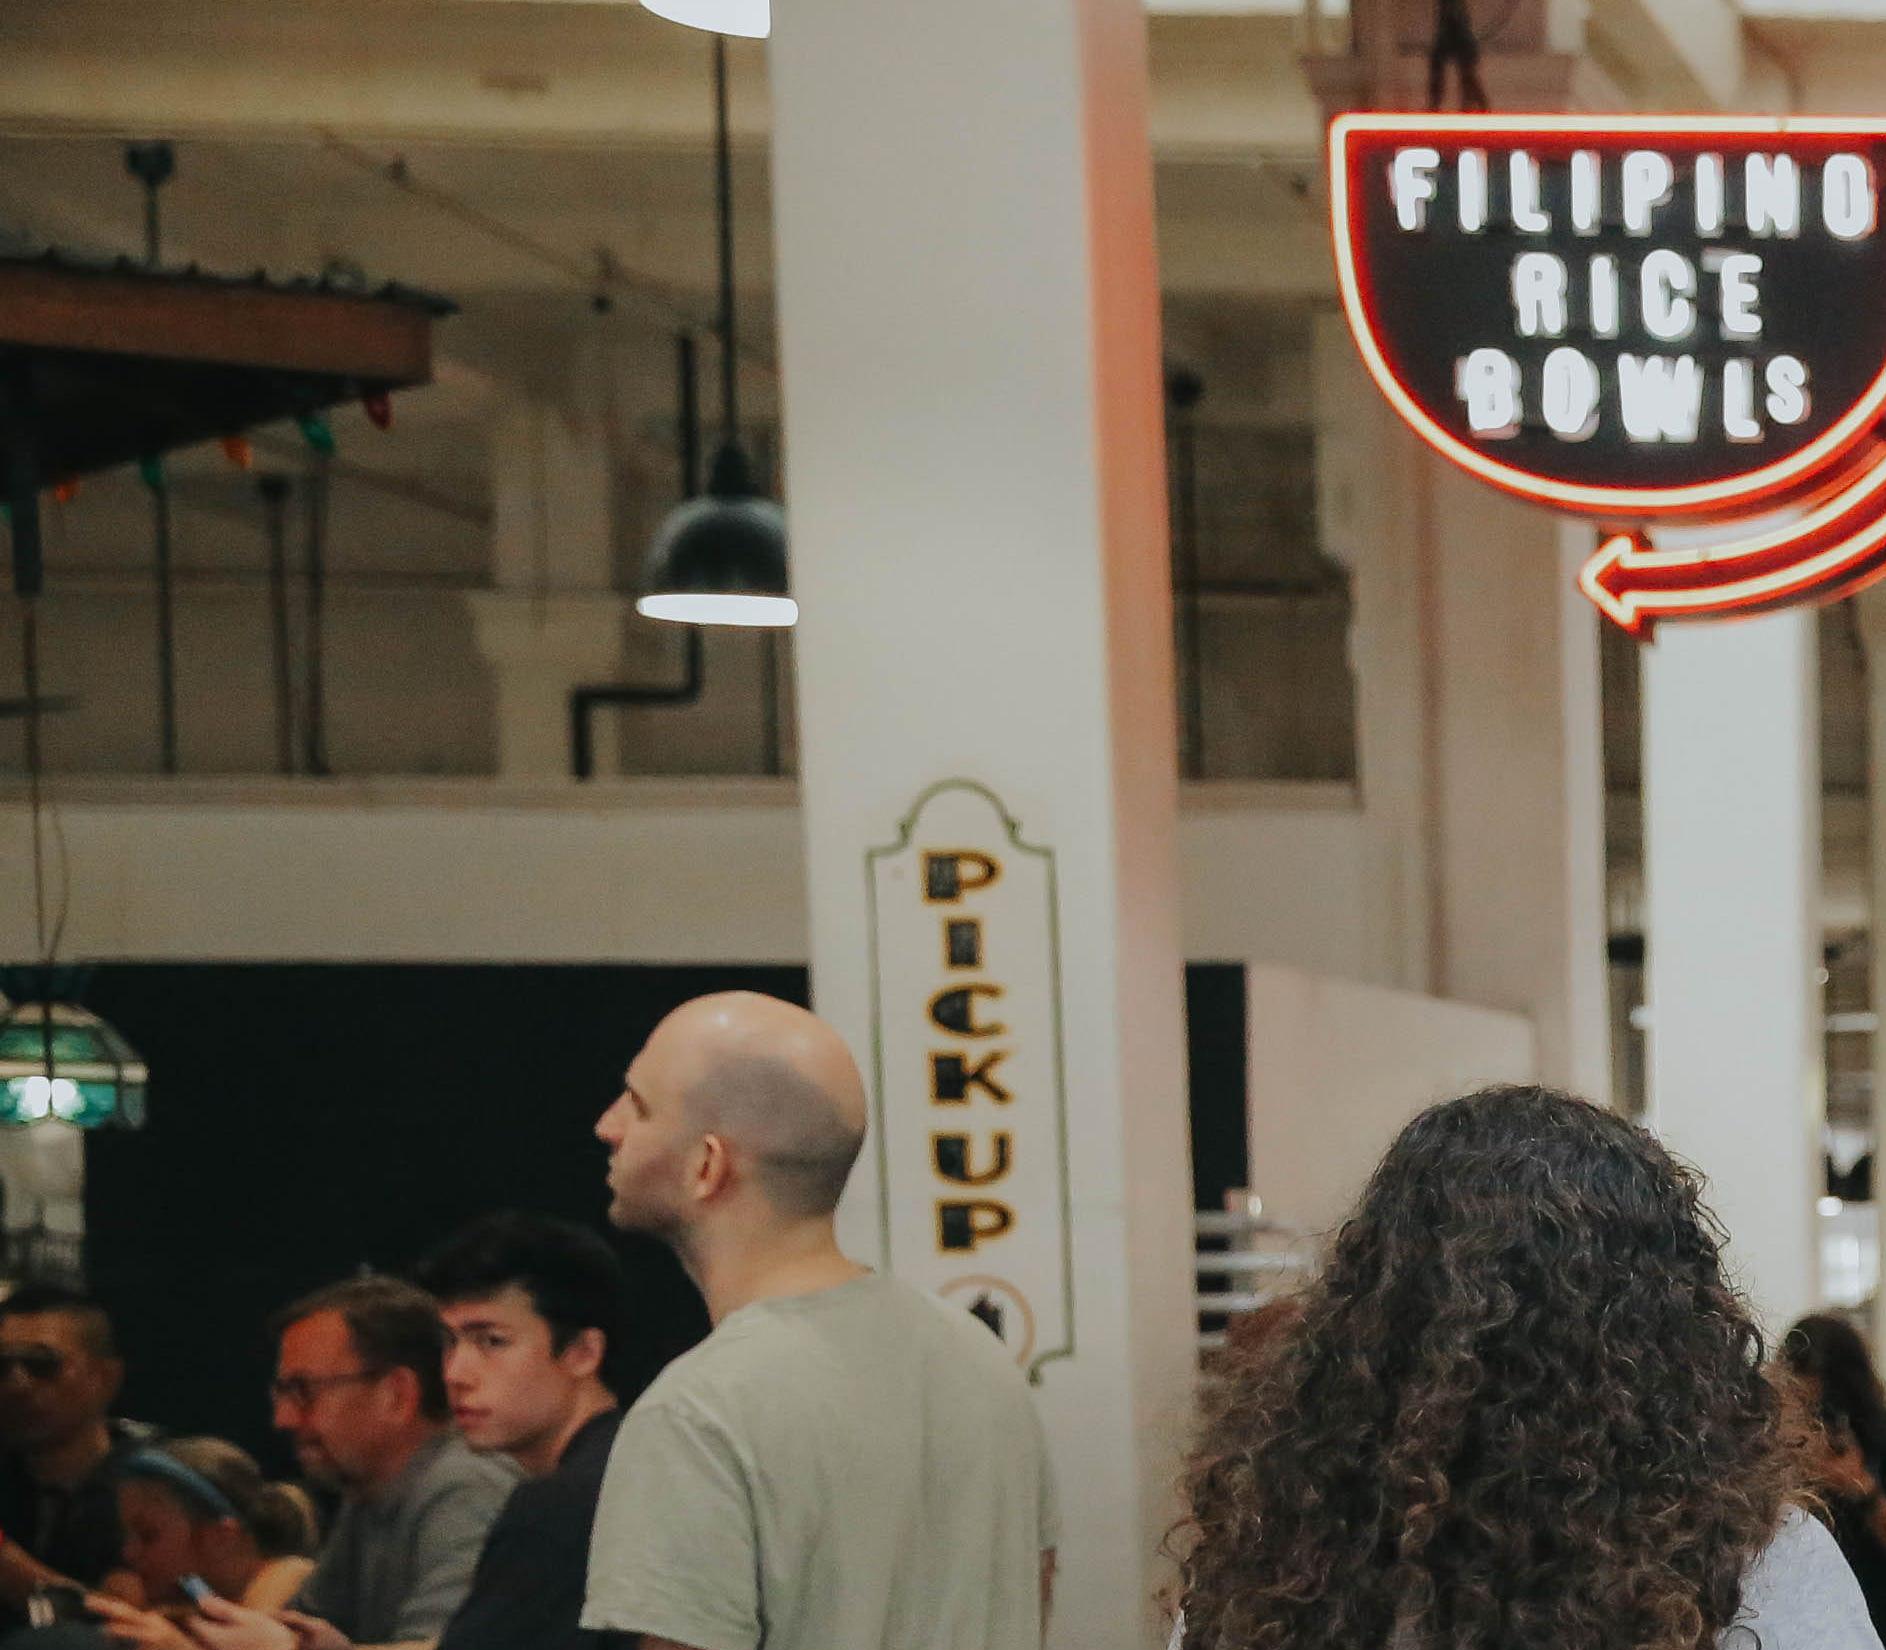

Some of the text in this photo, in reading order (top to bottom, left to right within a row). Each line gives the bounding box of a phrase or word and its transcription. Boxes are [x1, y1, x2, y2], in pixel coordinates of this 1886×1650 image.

[1388, 148, 1877, 242] FILIPINO
[1508, 250, 1764, 341] RICE
[1455, 348, 1812, 443] BOWLS
[921, 849, 1014, 1253] PICKUP
